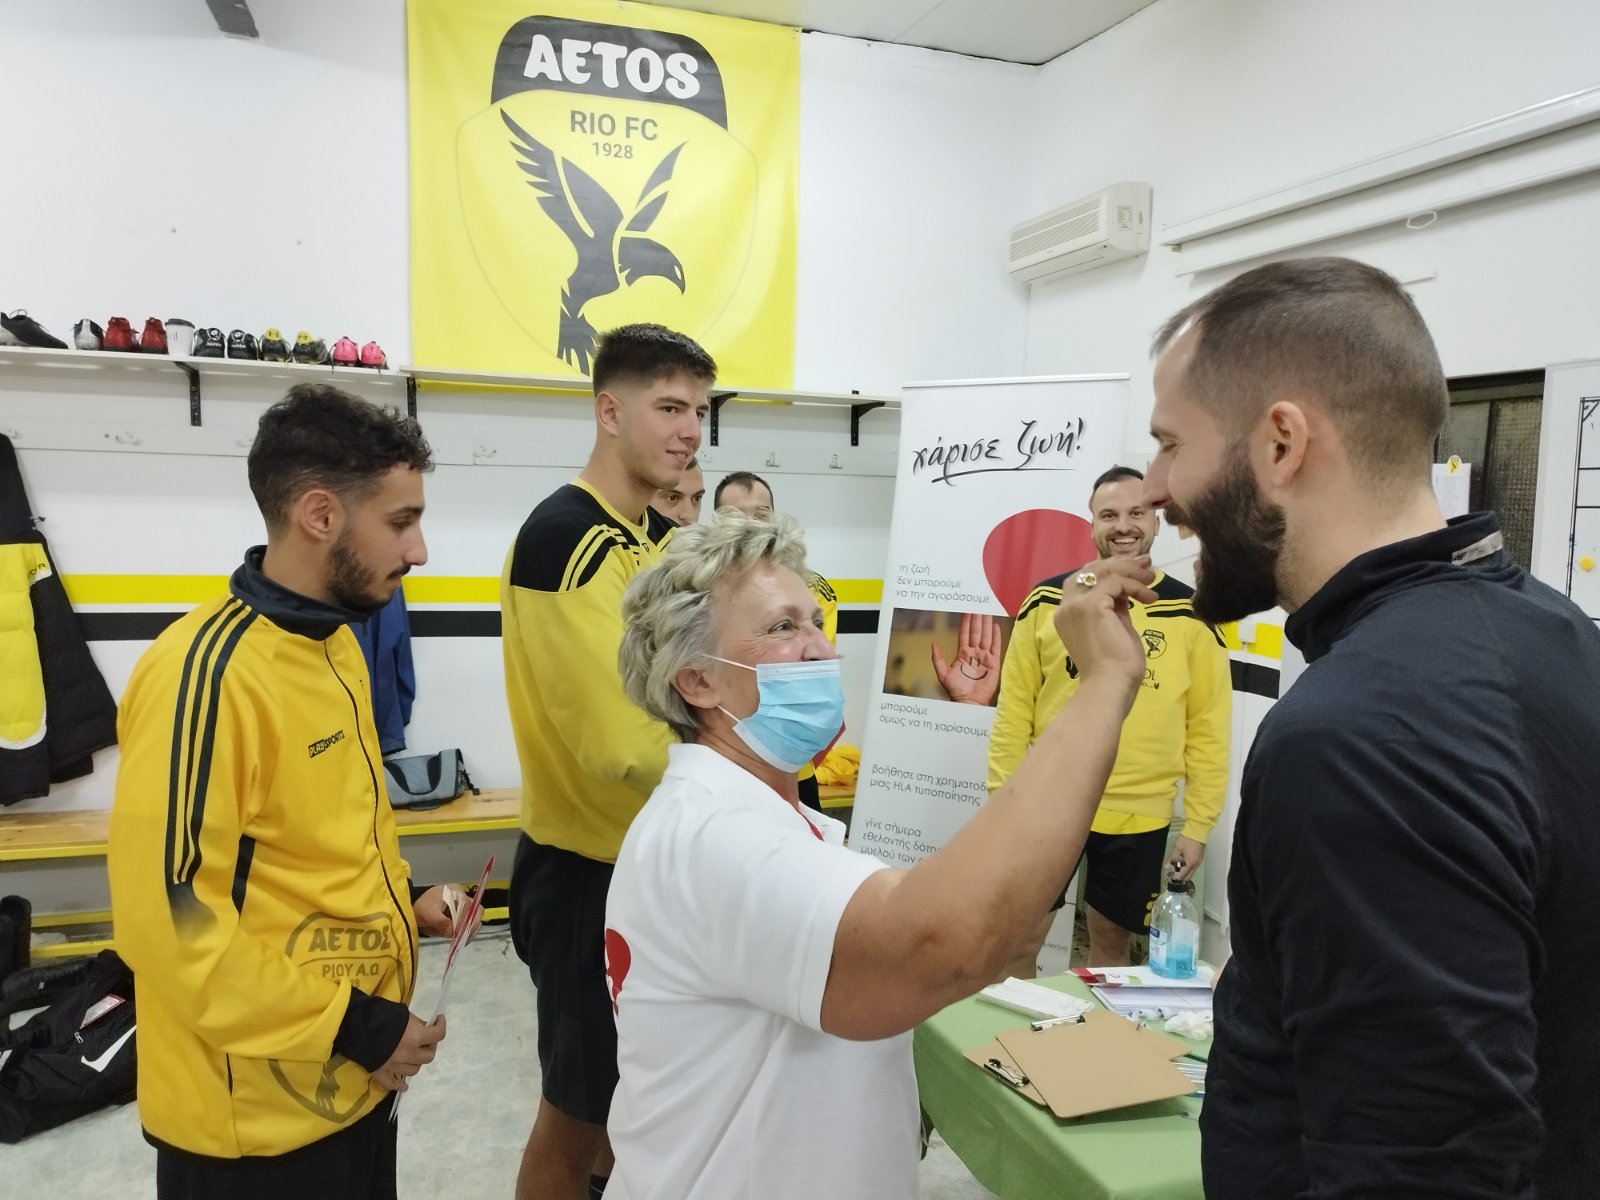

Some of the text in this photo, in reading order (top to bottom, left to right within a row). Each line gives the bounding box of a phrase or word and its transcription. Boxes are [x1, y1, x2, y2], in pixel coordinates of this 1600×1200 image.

[523, 34, 701, 99] AETOS
[570, 110, 658, 141] RIO FC
[592, 142, 633, 159] 1928
[912, 417, 1084, 486] χάρισε ζωή!
[899, 564, 930, 575] τη ζωή
[897, 576, 962, 589] δεν μπορούμε
[896, 590, 990, 604] να την αγοράσουμε
[880, 702, 928, 716] μπορούμε
[879, 713, 988, 737] όμως να τη χαρίσουμε
[872, 763, 987, 792] βοήθησε στη χρηματοδ
[870, 778, 982, 807] μιας HLA τυποποίησης
[865, 818, 921, 838] γίνε σήμερα
[862, 831, 942, 854] εθελοντής δότη
[860, 846, 895, 859] μυελού
[898, 853, 916, 863] των
[308, 925, 390, 953] ΑΕΤΟΣ
[322, 963, 354, 978] ΡΙΟΥ
